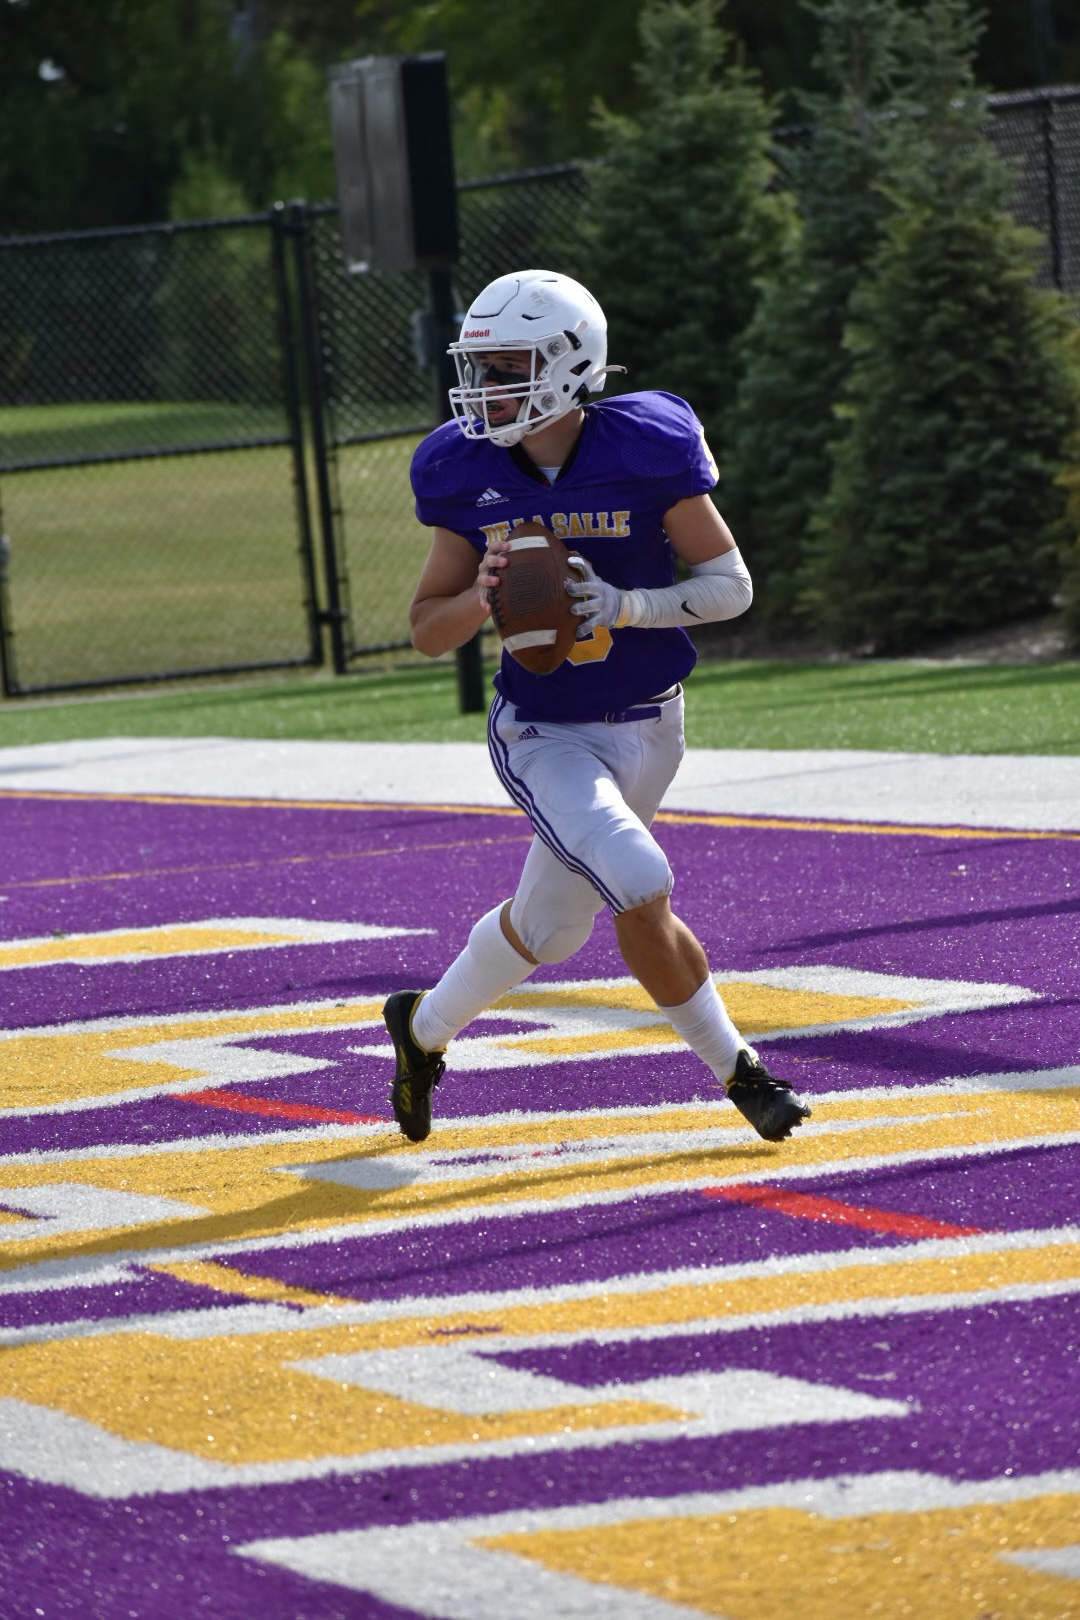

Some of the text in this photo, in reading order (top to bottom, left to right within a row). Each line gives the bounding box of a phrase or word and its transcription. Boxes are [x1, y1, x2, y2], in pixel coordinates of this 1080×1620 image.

[464, 329, 490, 339] Riddell
[475, 497, 510, 508] adidas
[551, 510, 631, 540] SALLE
